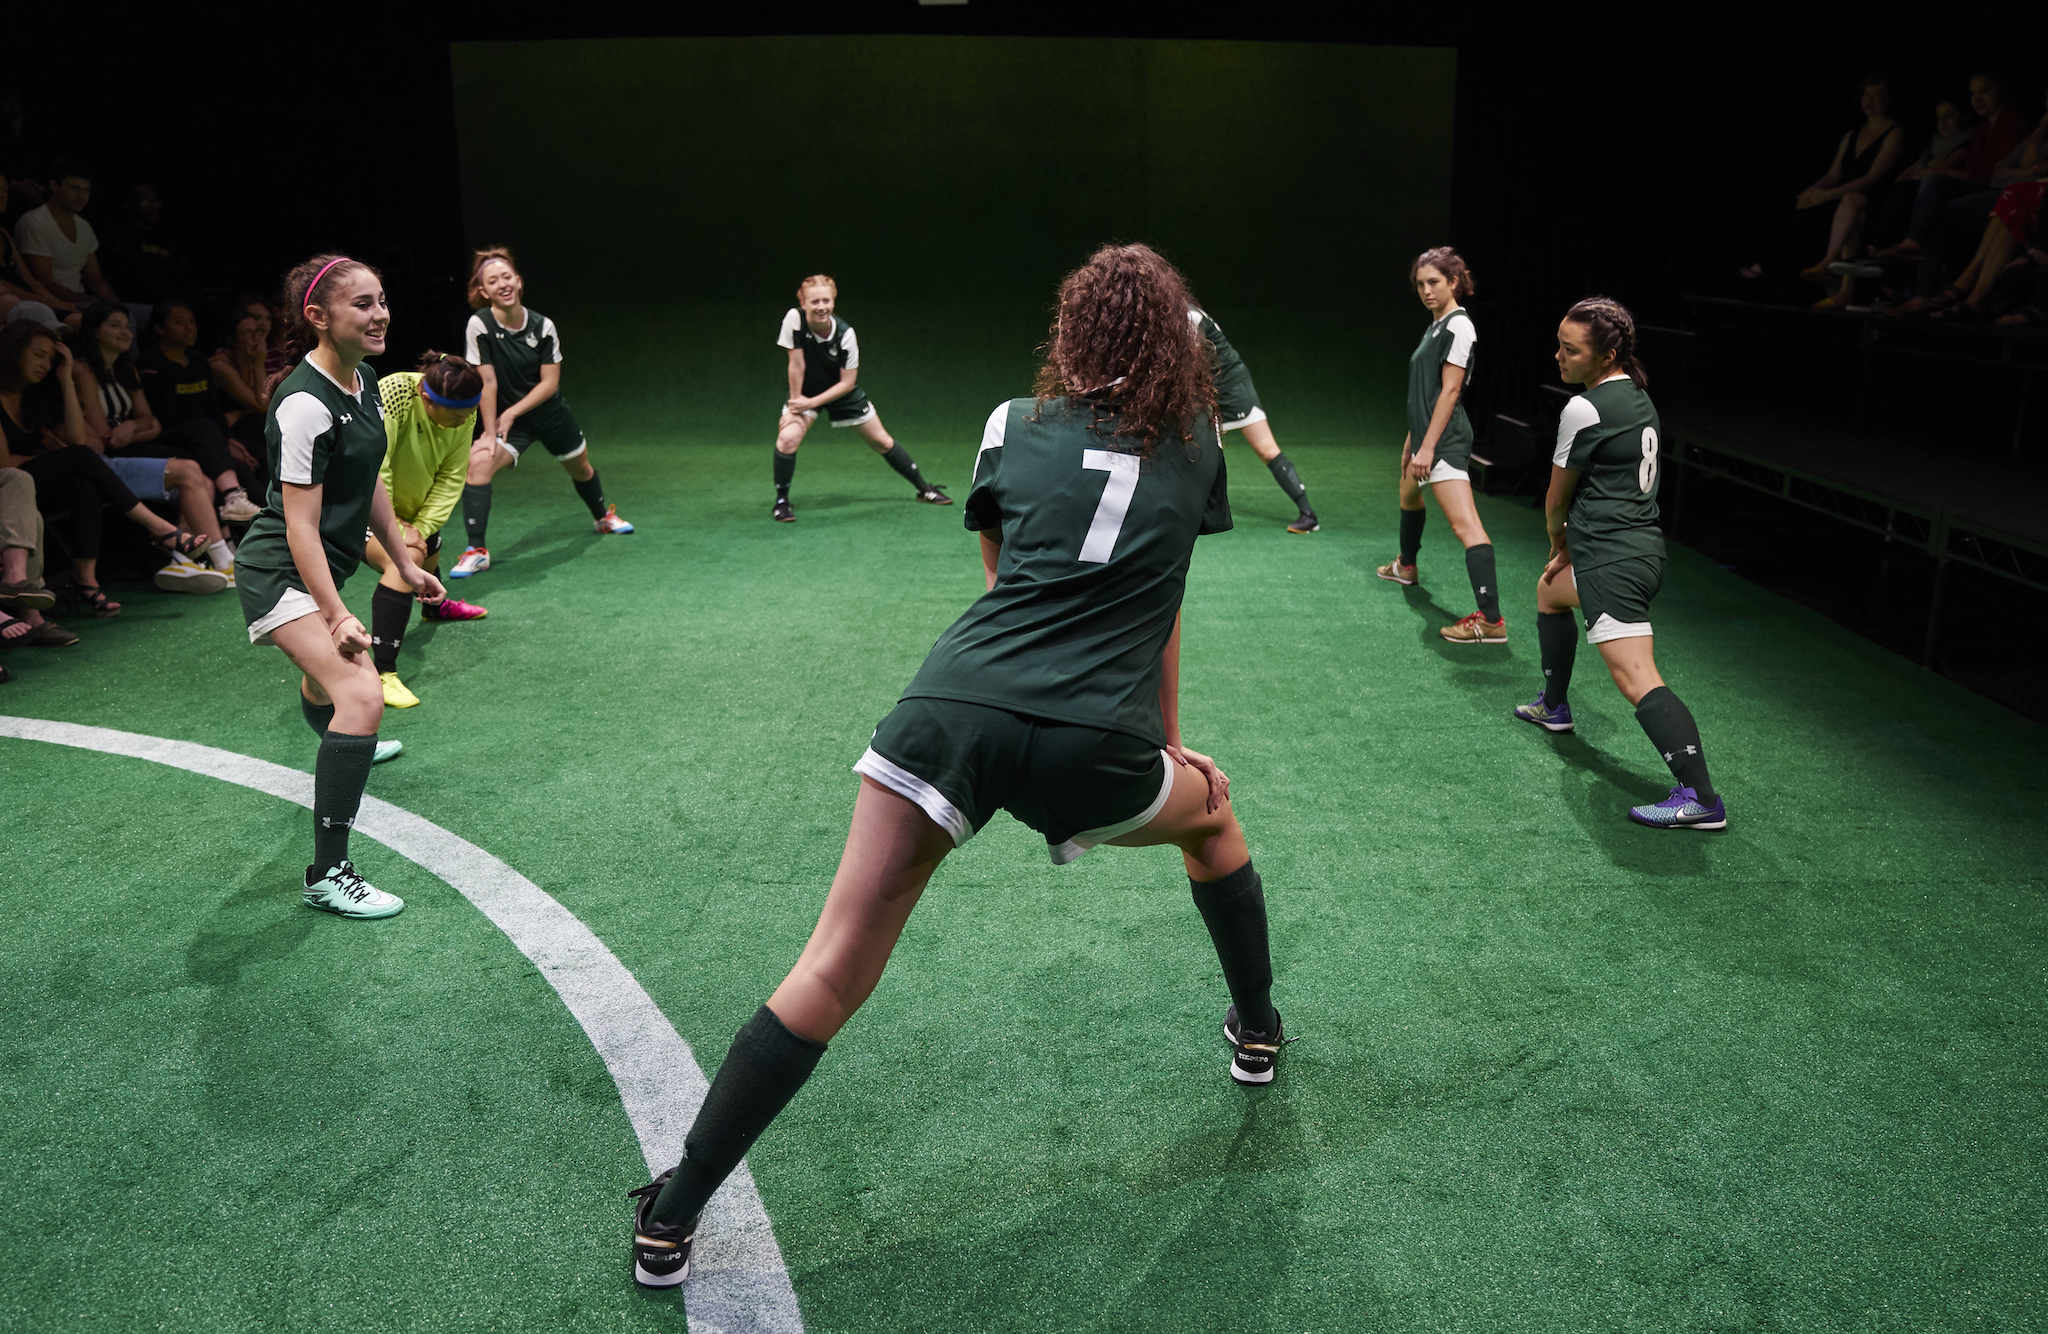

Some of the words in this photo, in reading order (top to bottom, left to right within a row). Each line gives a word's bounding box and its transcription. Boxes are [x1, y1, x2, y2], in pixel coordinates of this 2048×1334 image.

[176, 379, 208, 395] DUKE
[1638, 426, 1658, 494] 8
[1078, 448, 1141, 564] 7
